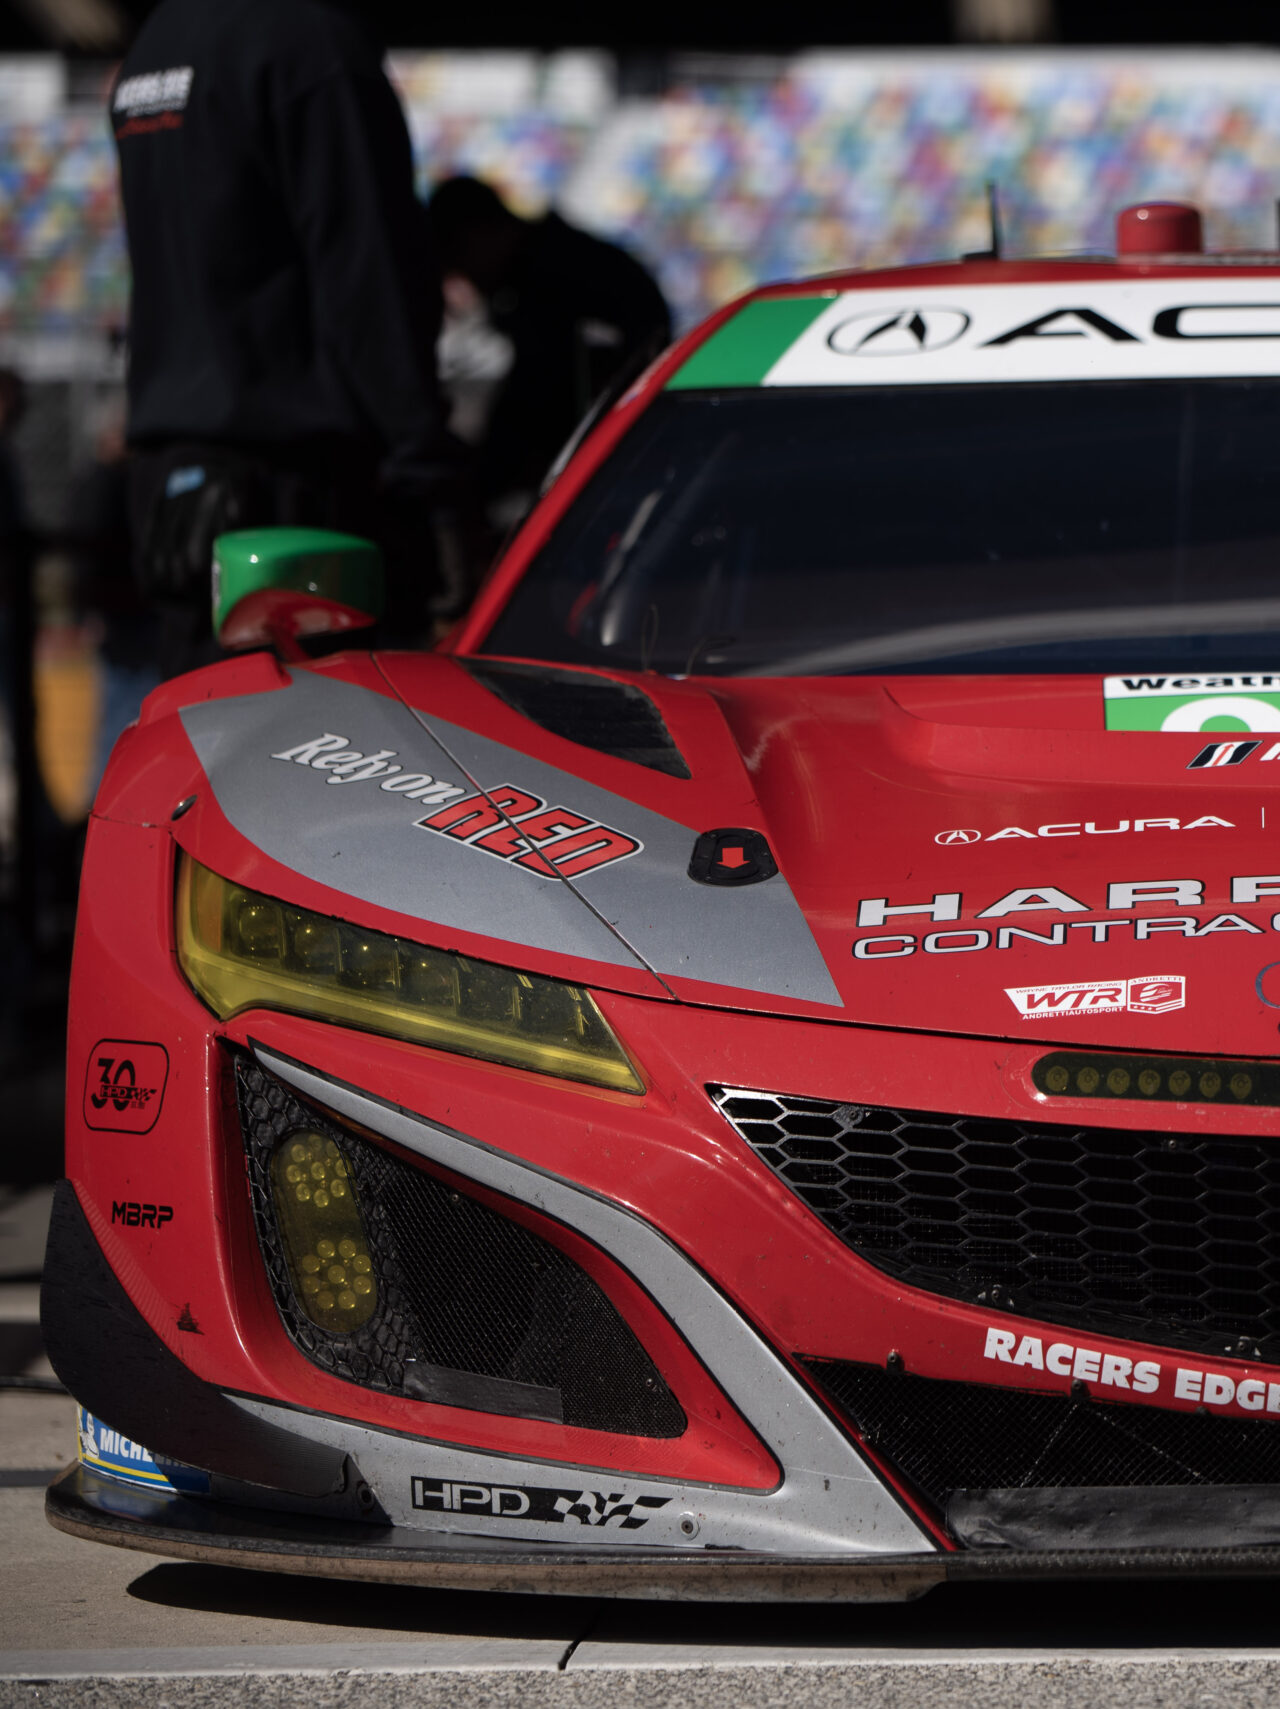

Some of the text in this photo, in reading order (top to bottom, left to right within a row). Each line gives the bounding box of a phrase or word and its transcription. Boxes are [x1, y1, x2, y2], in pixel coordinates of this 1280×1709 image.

[271, 733, 645, 881] Rely on RED
[984, 815, 1237, 842] ACURA
[1027, 988, 1123, 1009] WTR
[112, 1201, 173, 1228] MBRP
[983, 1327, 1161, 1394] RACERS
[415, 1480, 530, 1516] HPD
